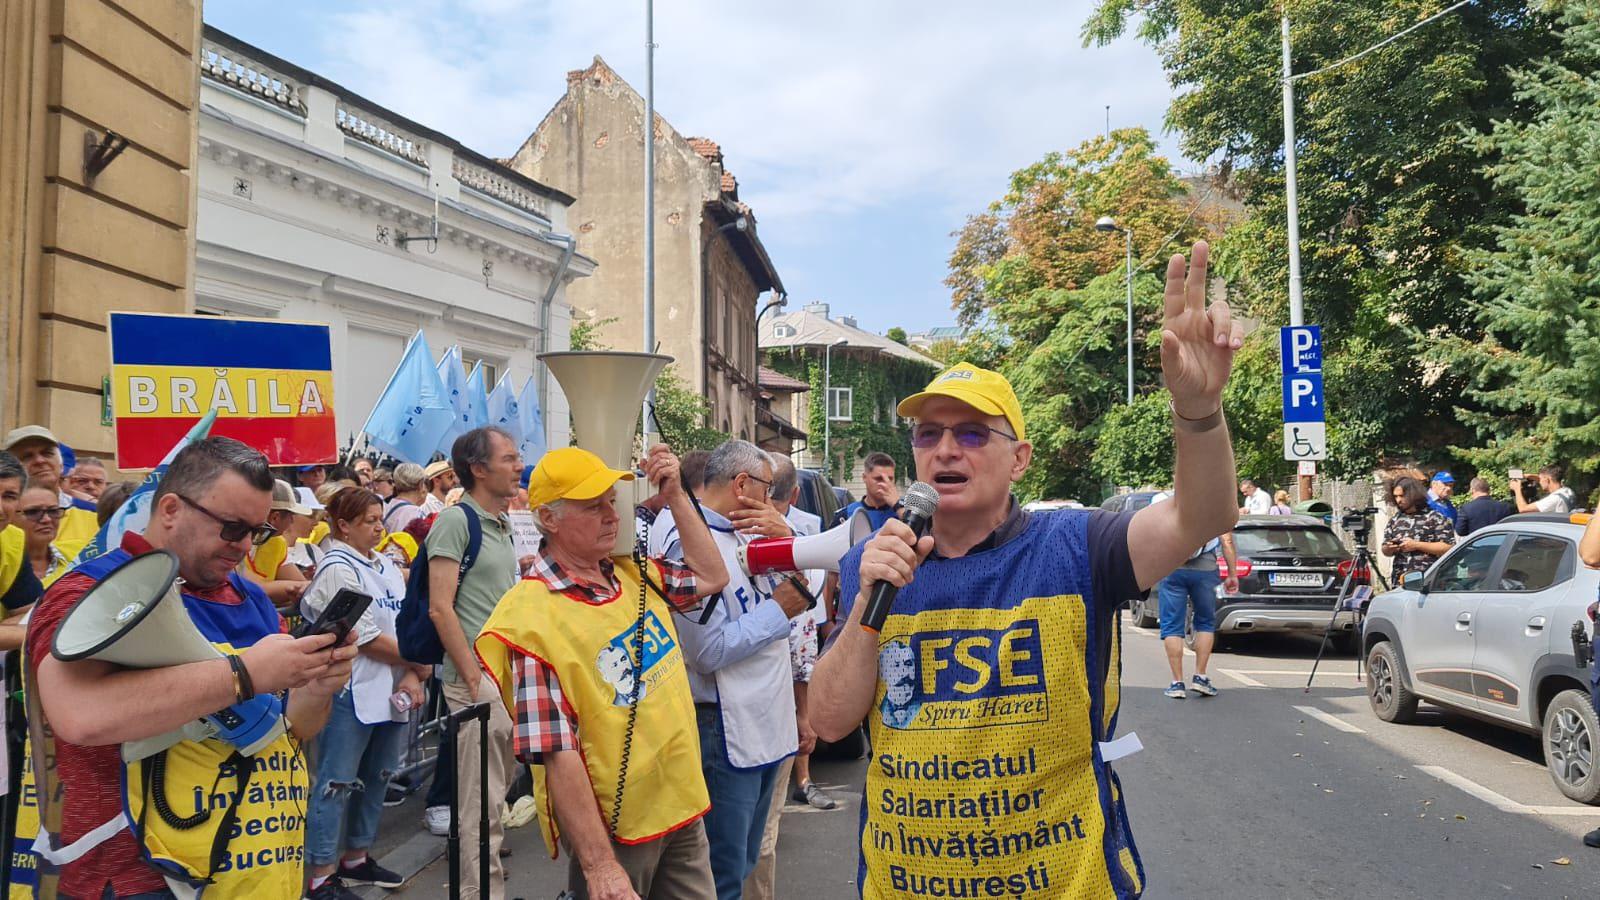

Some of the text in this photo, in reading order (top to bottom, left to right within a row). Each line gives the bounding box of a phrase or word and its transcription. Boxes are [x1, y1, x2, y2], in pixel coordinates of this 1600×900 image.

[1292, 329, 1314, 368] P
[128, 368, 325, 415] BRĂILA
[1291, 379, 1314, 407] P
[920, 628, 1040, 695] FSE
[919, 696, 1046, 727] Spiru Haret
[879, 747, 1036, 780] Sindicatul
[880, 788, 1044, 827] Salariaților
[869, 813, 1086, 867] in Învățământ
[890, 861, 1050, 900] București
